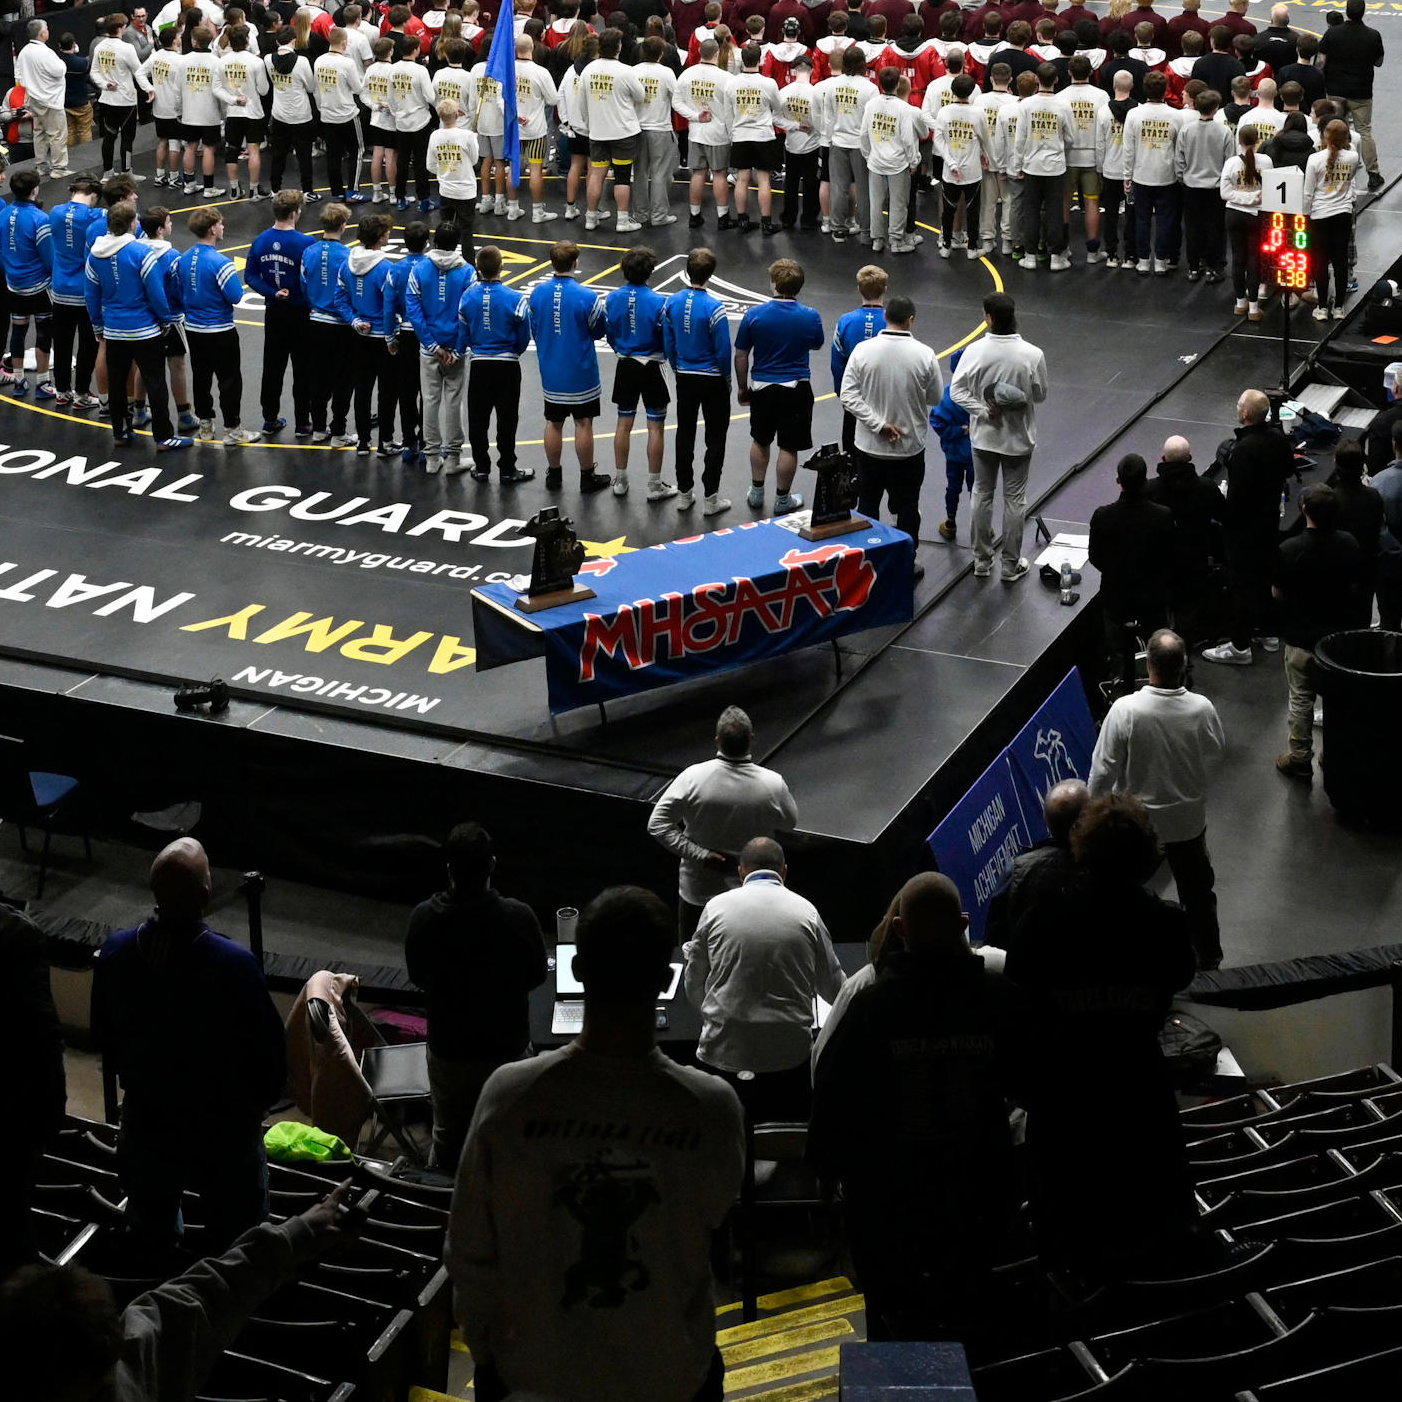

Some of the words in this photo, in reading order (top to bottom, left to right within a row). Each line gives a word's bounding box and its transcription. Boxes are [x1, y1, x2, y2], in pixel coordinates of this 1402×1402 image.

[186, 74, 210, 83] STATE
[225, 70, 246, 79] STATE
[272, 73, 292, 83] STATE
[368, 83, 388, 93] STATE
[393, 81, 412, 90] STATE
[590, 81, 612, 91] STATE
[438, 88, 460, 98] STATE
[692, 88, 714, 98] STATE
[736, 96, 760, 105] STATE
[835, 95, 857, 104] STATE
[787, 104, 809, 114] STATE
[1073, 110, 1094, 119] TATE
[872, 121, 895, 132] STATE
[1031, 120, 1057, 130] STATE
[948, 130, 974, 139] STATE
[1141, 128, 1169, 138] STATE
[437, 152, 461, 161] STATE
[1276, 182, 1286, 204] 1
[1273, 213, 1283, 229] 0
[1295, 214, 1305, 231] 0
[8, 217, 17, 252] DETROIT
[65, 213, 73, 248] DETROIT
[1272, 229, 1282, 246] 0
[1295, 232, 1306, 249] 0
[191, 256, 199, 293] DETROIT
[482, 295, 491, 331] DETROIT
[554, 291, 562, 334] DETROIT
[684, 298, 692, 334] DETROIT
[229, 485, 536, 548] GUARD
[219, 530, 524, 584] miarmyguard.c
[578, 558, 850, 684] MHSAA
[178, 603, 477, 675] ARMY
[232, 666, 442, 715] MICHIGAN
[968, 793, 1006, 855] MICHIGAN
[973, 823, 1023, 908] ACHIEVEMENT
